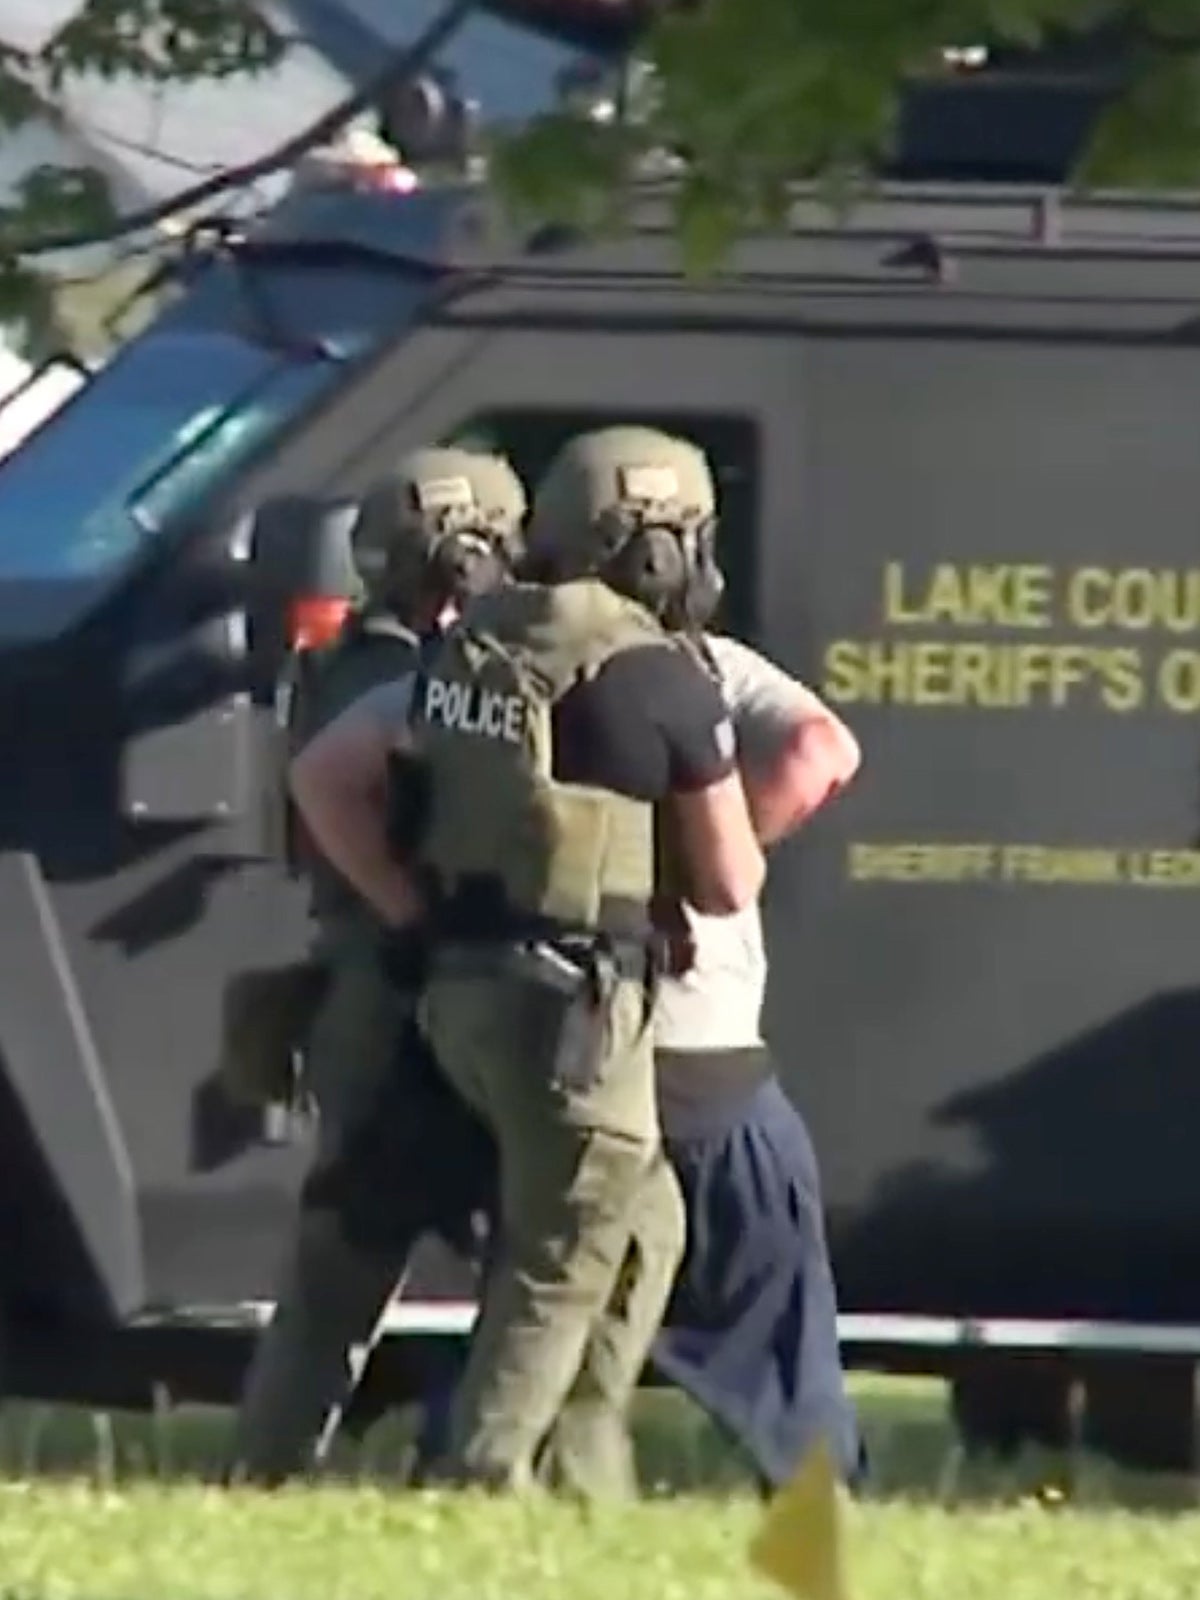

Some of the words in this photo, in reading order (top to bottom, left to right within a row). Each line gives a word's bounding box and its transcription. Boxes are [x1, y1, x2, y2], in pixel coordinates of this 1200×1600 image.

[884, 562, 1053, 629] LAKE
[823, 640, 1142, 710] SHERIFF'S
[425, 677, 525, 743] POLICE
